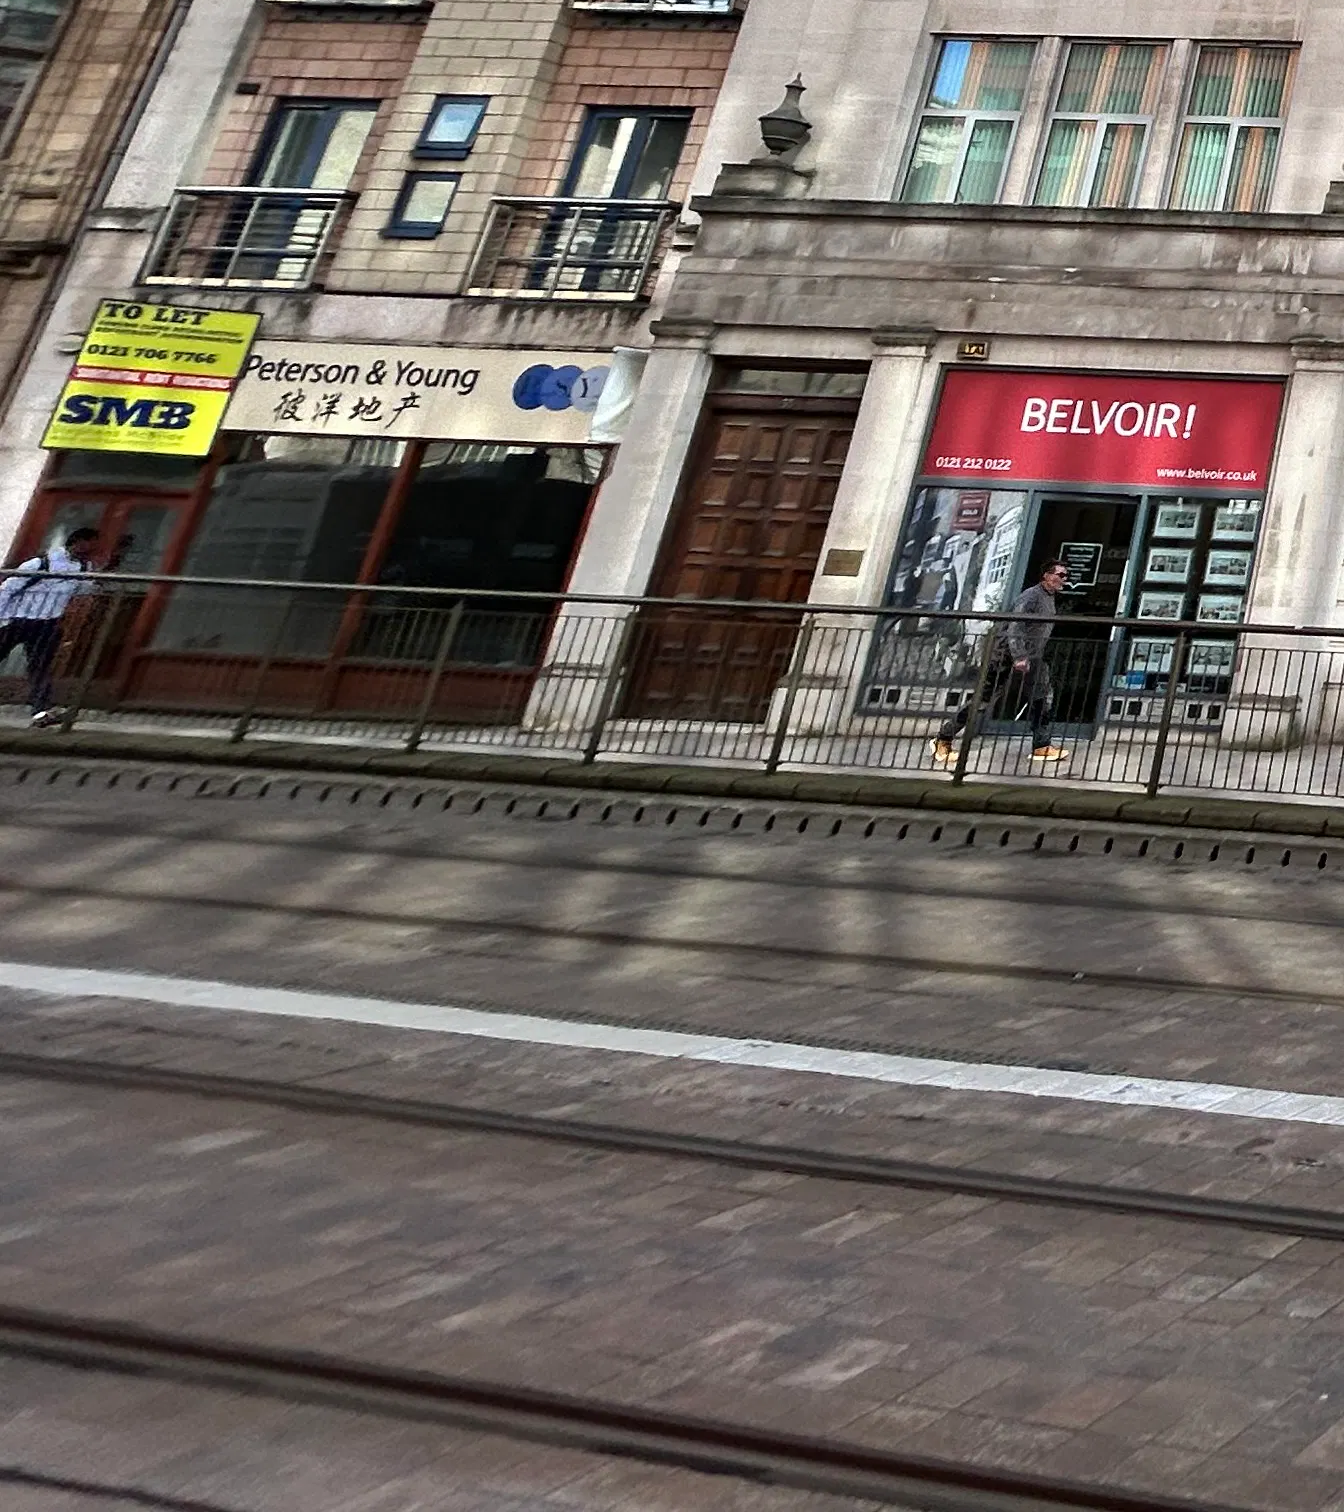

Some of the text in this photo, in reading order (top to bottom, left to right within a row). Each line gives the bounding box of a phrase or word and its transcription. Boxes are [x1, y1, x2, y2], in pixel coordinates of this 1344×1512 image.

[104, 303, 211, 325] TO LET
[87, 343, 219, 365] 0121 706 7766
[240, 354, 360, 386] Peterson
[365, 359, 388, 386] &
[394, 360, 482, 396] Young
[60, 394, 196, 430] SMB
[1020, 397, 1197, 439] BELVOIR!
[935, 456, 1012, 471] 0121 212 0122
[1156, 467, 1257, 482] www.belvoir.co.uk
